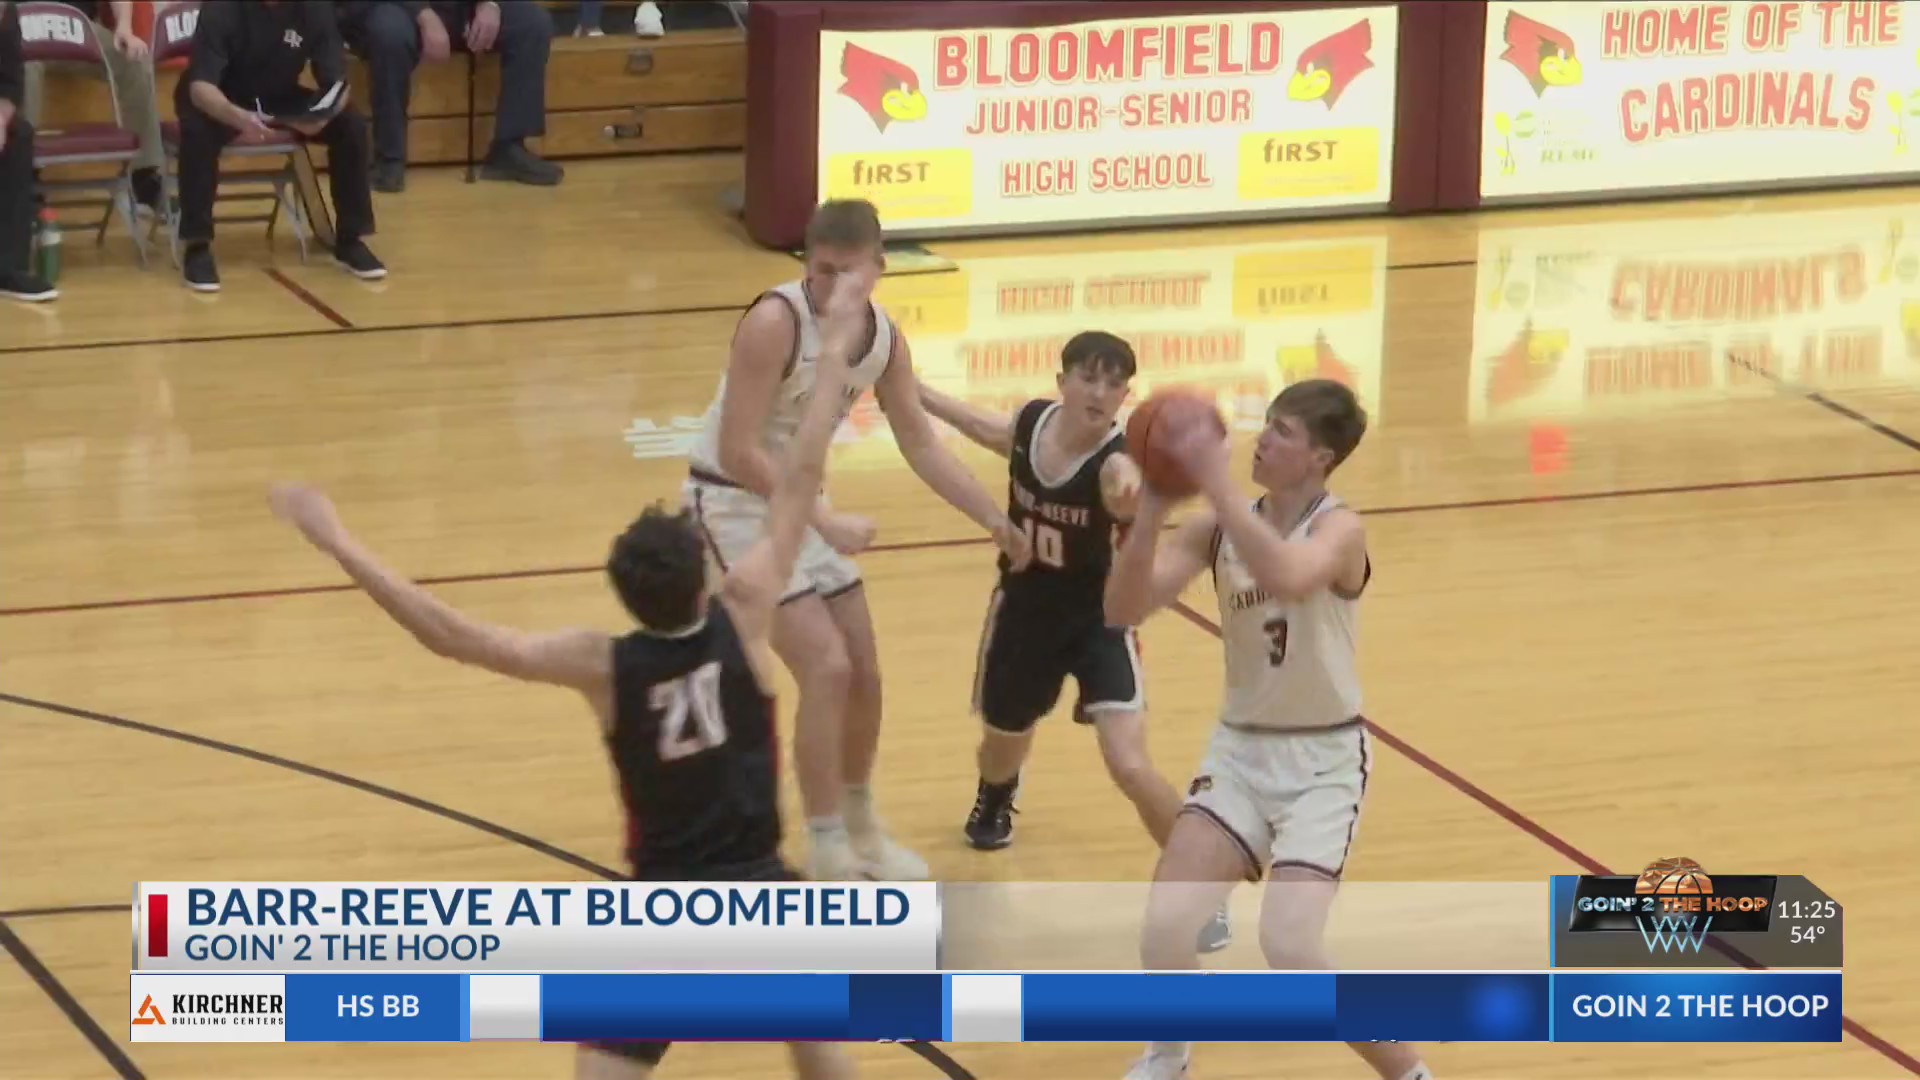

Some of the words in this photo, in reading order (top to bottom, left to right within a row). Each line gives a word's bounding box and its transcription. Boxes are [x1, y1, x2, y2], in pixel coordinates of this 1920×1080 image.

[933, 21, 1282, 90] BLOOMFIELD
[1602, 4, 1729, 58] HOME
[1742, 4, 1802, 53] OF
[1809, 2, 1901, 49] THE
[966, 89, 1253, 136] JUNIOR-SENIOR
[1618, 69, 1877, 145] CARDINALS
[1001, 158, 1077, 197] HIGH
[1088, 153, 1212, 193] SCHOOL
[1263, 618, 1288, 667] 3
[648, 660, 728, 762] 20
